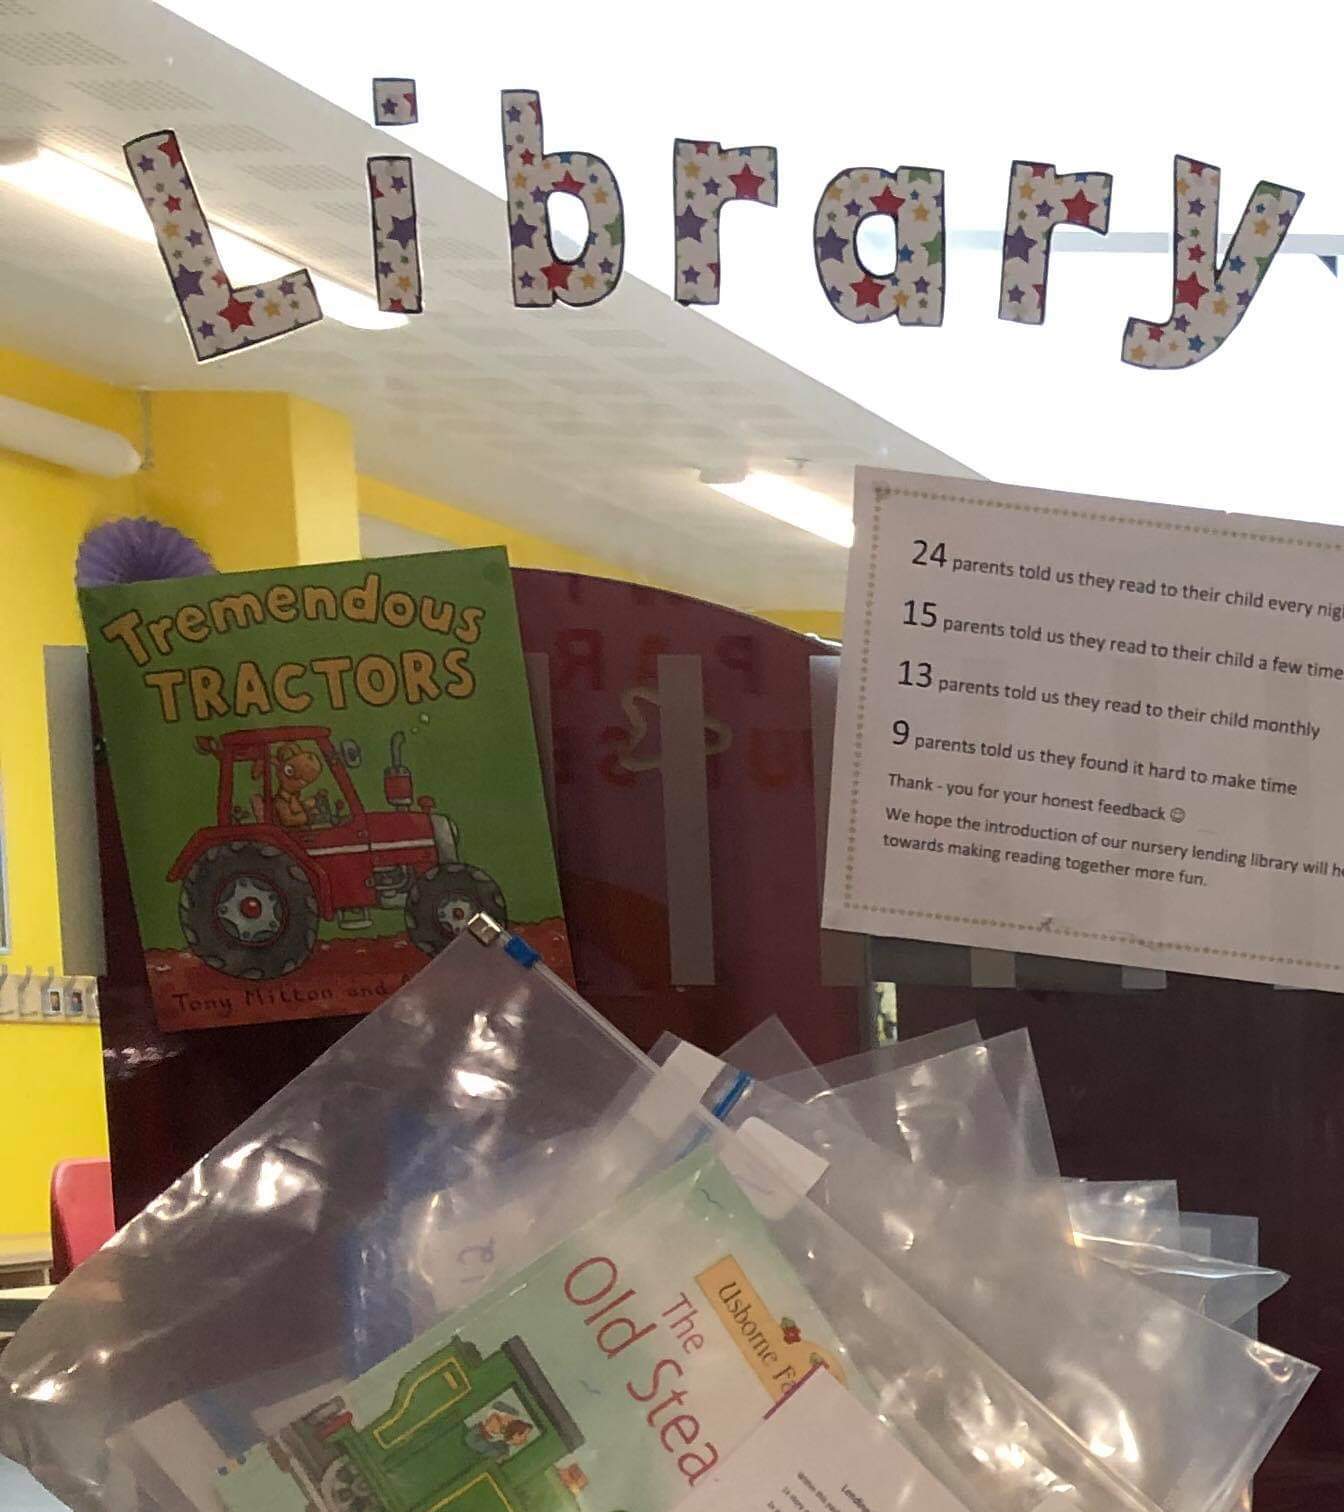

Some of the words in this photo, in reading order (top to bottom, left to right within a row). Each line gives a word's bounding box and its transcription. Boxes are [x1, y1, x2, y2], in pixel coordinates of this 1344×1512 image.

[122, 77, 1304, 370] Library
[911, 539, 949, 569] 24
[951, 558, 1015, 577] parents
[1019, 564, 1052, 582] told
[1055, 571, 1075, 585] us
[1078, 571, 1116, 593] they
[1118, 579, 1157, 595] read
[1160, 582, 1179, 598] to
[1182, 584, 1222, 603] their
[1224, 589, 1264, 609] child
[1268, 598, 1314, 618] every
[103, 573, 486, 667] Tremendous
[144, 649, 476, 723] TRACTORS
[891, 719, 911, 746] 9
[914, 736, 977, 755] parents
[980, 742, 1013, 759] told
[1016, 749, 1036, 762] us
[1039, 748, 1077, 771] they
[1079, 752, 1129, 774] found
[1132, 760, 1145, 777] it
[1148, 761, 1186, 782] hard
[1190, 769, 1209, 784] to
[1211, 773, 1257, 791] make
[1260, 777, 1298, 796] time
[171, 992, 234, 1014] Tony
[244, 988, 335, 1007] Mitton
[661, 1292, 705, 1354] The
[718, 1281, 779, 1363] Usborne
[563, 1256, 658, 1360] Old
[626, 1358, 720, 1487] Stea
